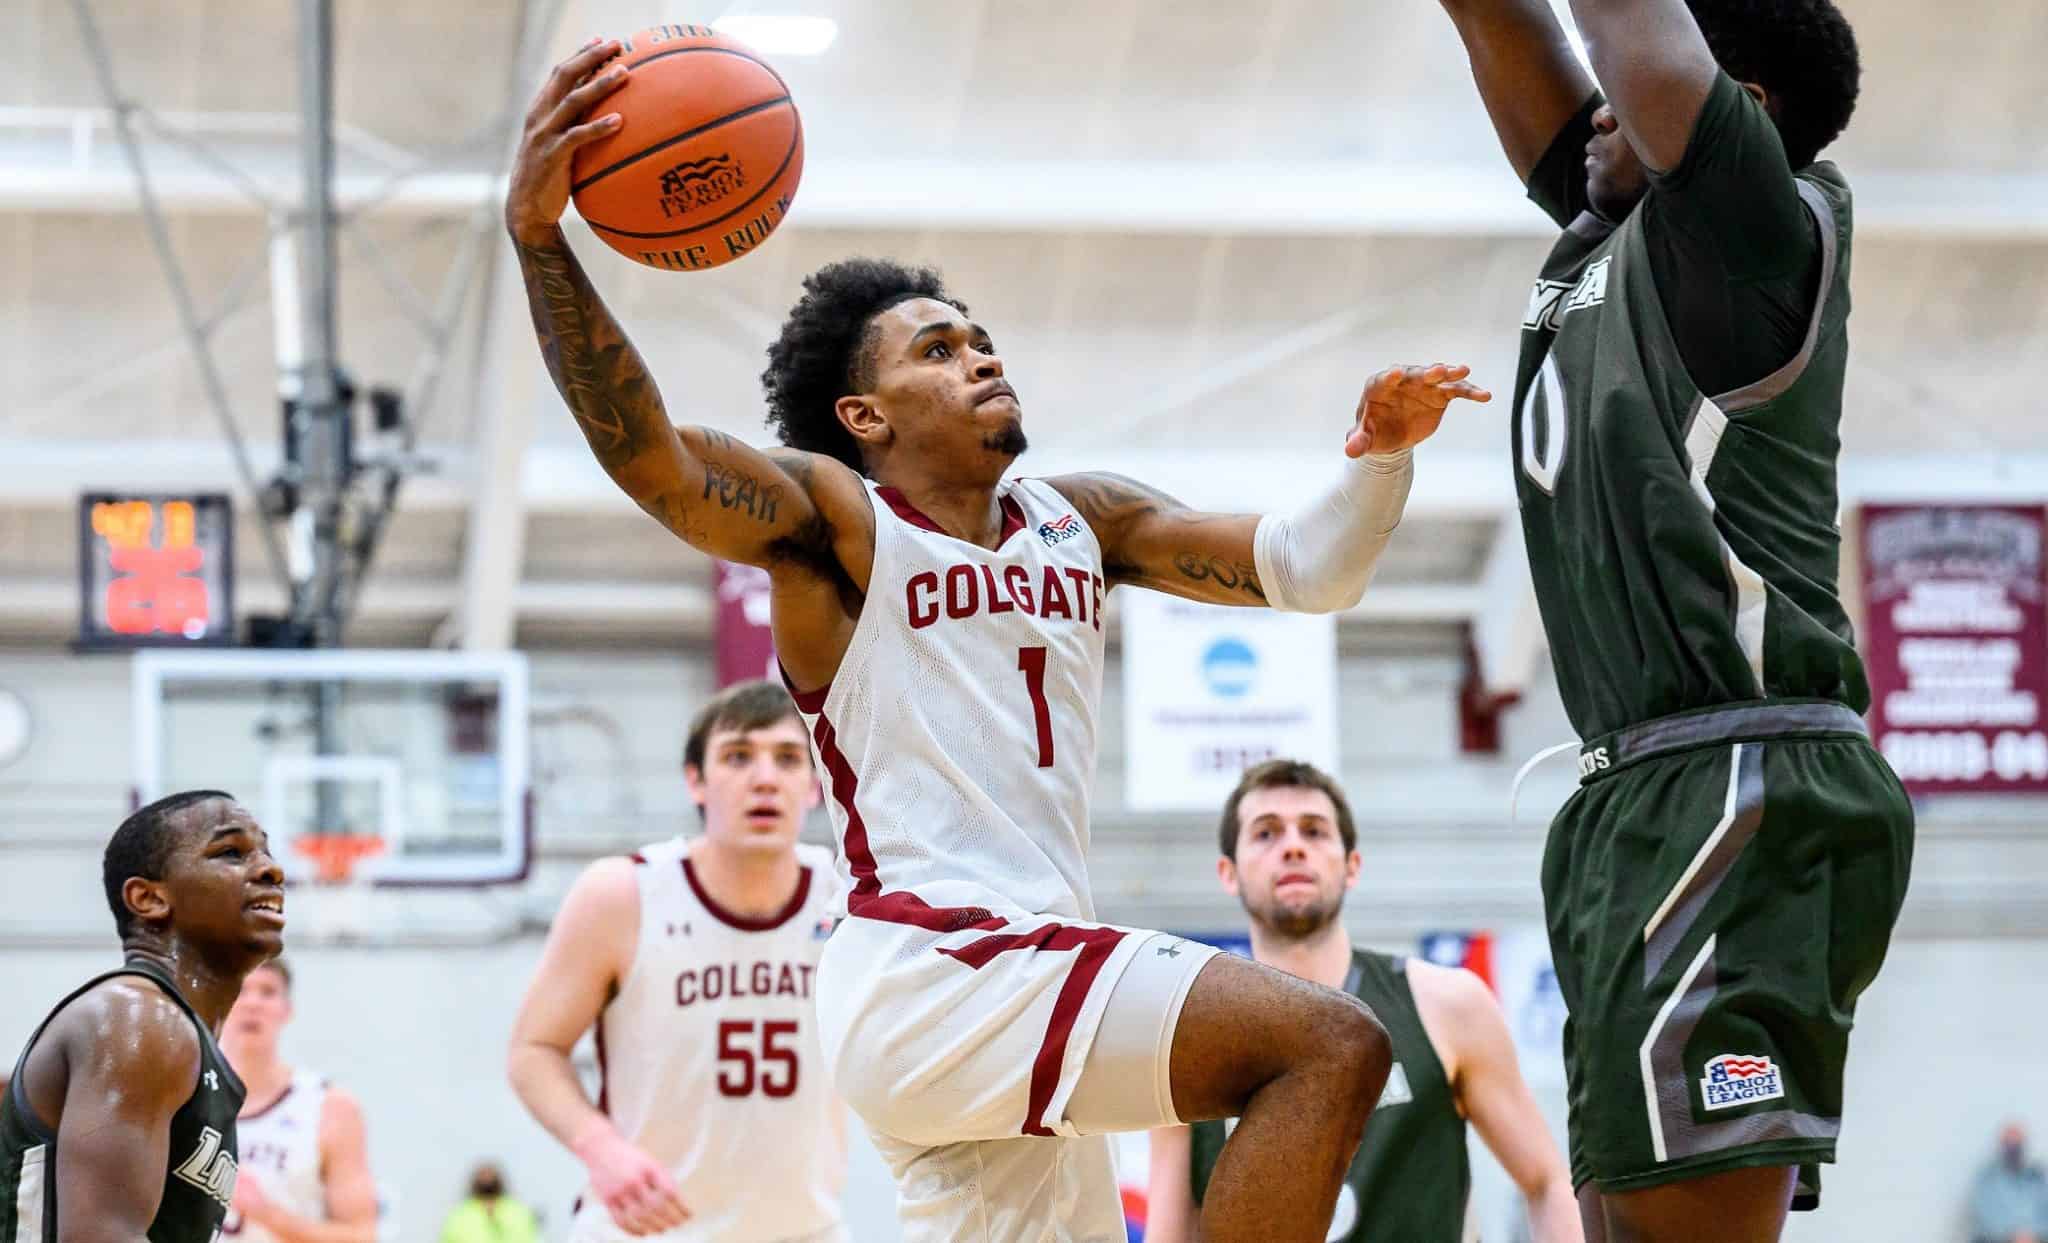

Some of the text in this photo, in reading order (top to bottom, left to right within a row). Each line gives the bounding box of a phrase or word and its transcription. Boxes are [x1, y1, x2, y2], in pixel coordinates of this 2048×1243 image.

[637, 245, 712, 268] THE
[905, 563, 1103, 632] COLGATE
[1018, 647, 1054, 768] 1
[676, 961, 817, 1007] COLGAT
[717, 1020, 799, 1099] 55
[1707, 1074, 1777, 1095] PATRIOT
[1709, 1084, 1777, 1105] LEAGUE
